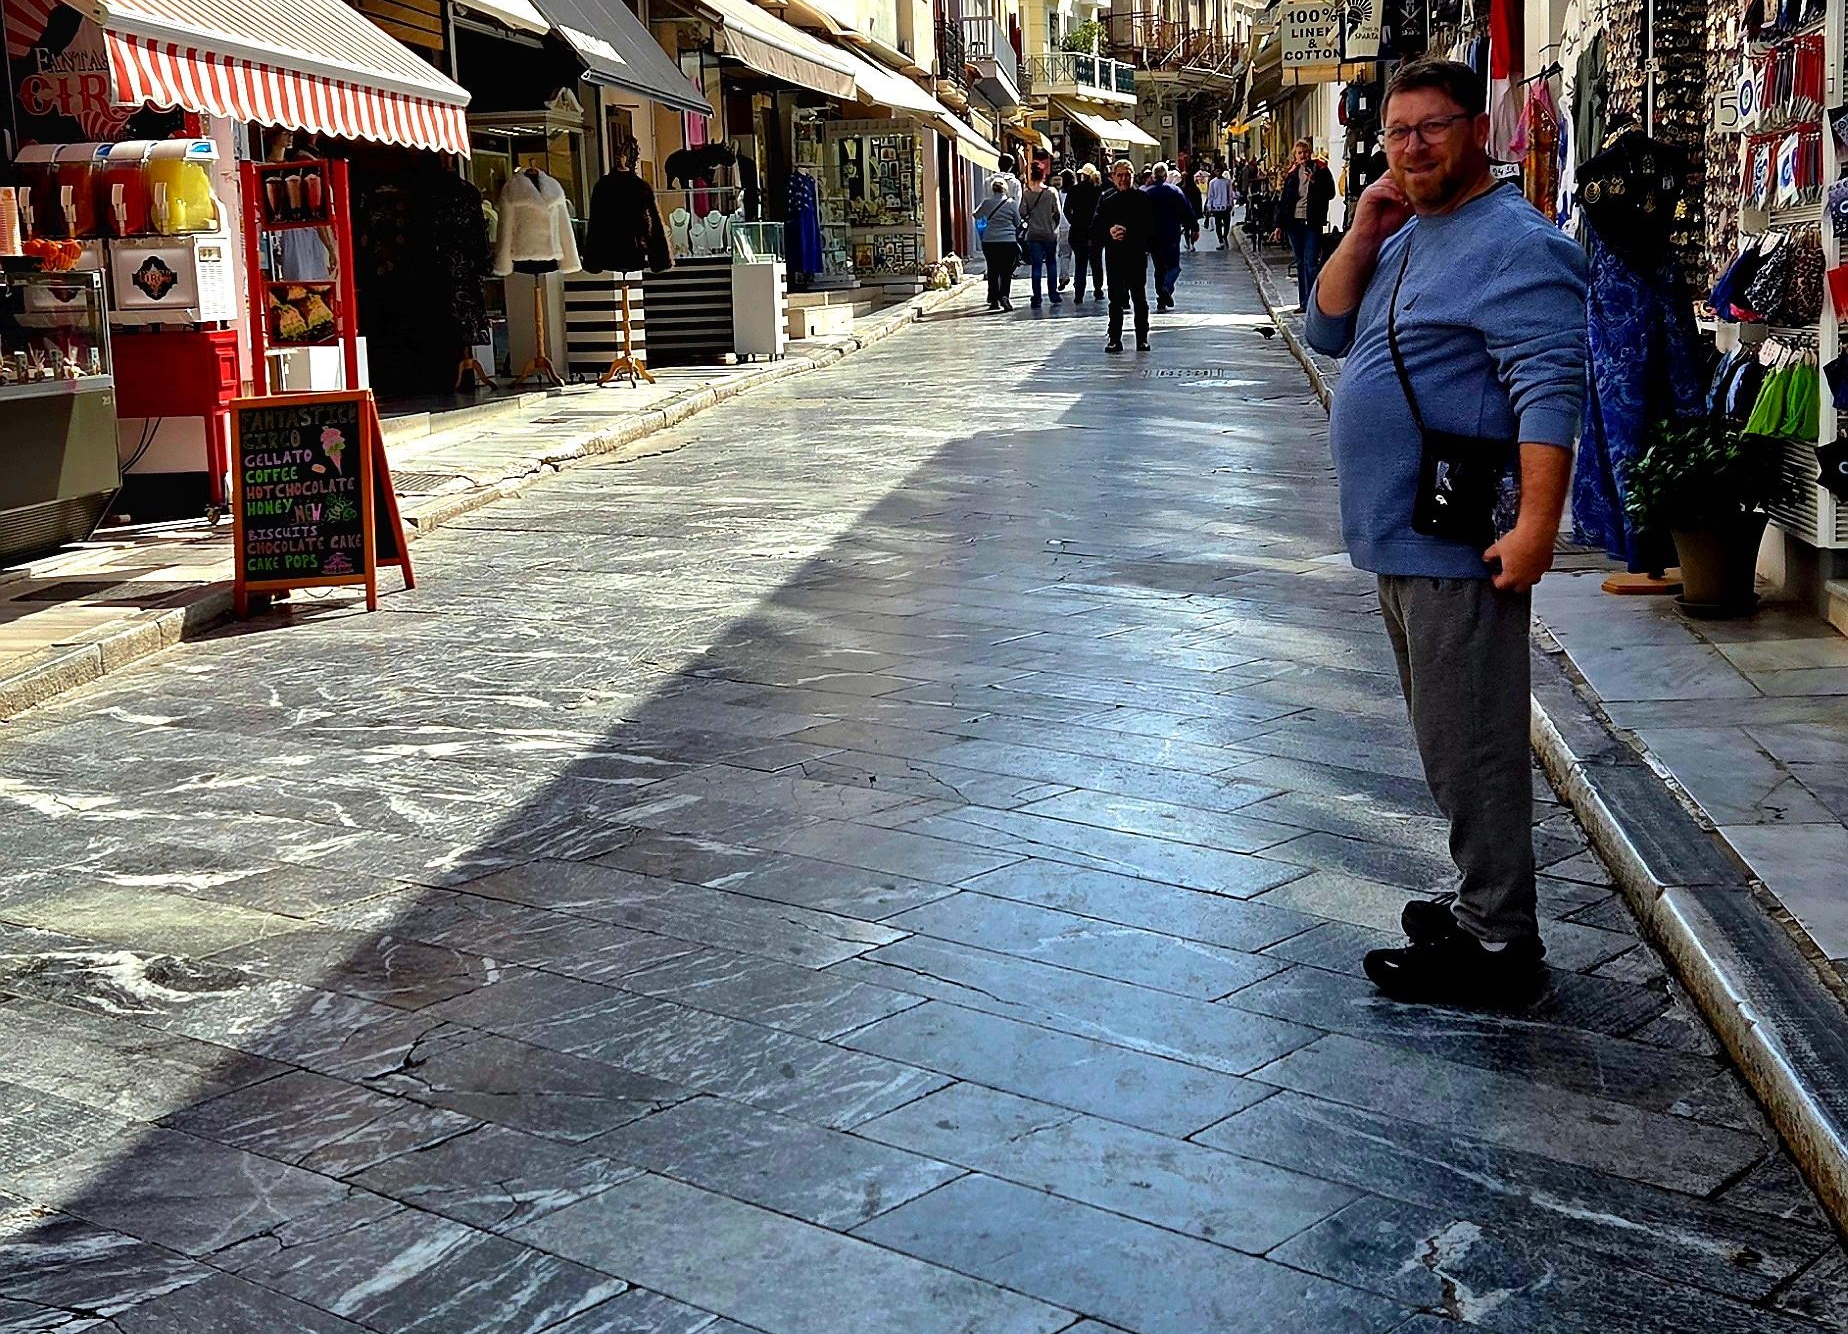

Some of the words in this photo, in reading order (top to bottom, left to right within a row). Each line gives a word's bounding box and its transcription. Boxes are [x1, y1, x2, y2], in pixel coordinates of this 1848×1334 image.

[1287, 8, 1338, 24] 100%
[1308, 38, 1318, 49] &
[34, 47, 110, 73] FANTAS
[1284, 47, 1342, 61] COTTON
[18, 74, 150, 123] CIR
[244, 449, 313, 467] GELLATO
[245, 466, 299, 484] COFFEE
[247, 498, 294, 516] HONEY
[294, 503, 322, 524] NEW
[247, 525, 319, 541] BISCUITS
[247, 536, 325, 555] CHOCOLATE
[330, 534, 362, 549] CAKE
[247, 556, 280, 571] CAKE
[284, 554, 318, 569] POPS
